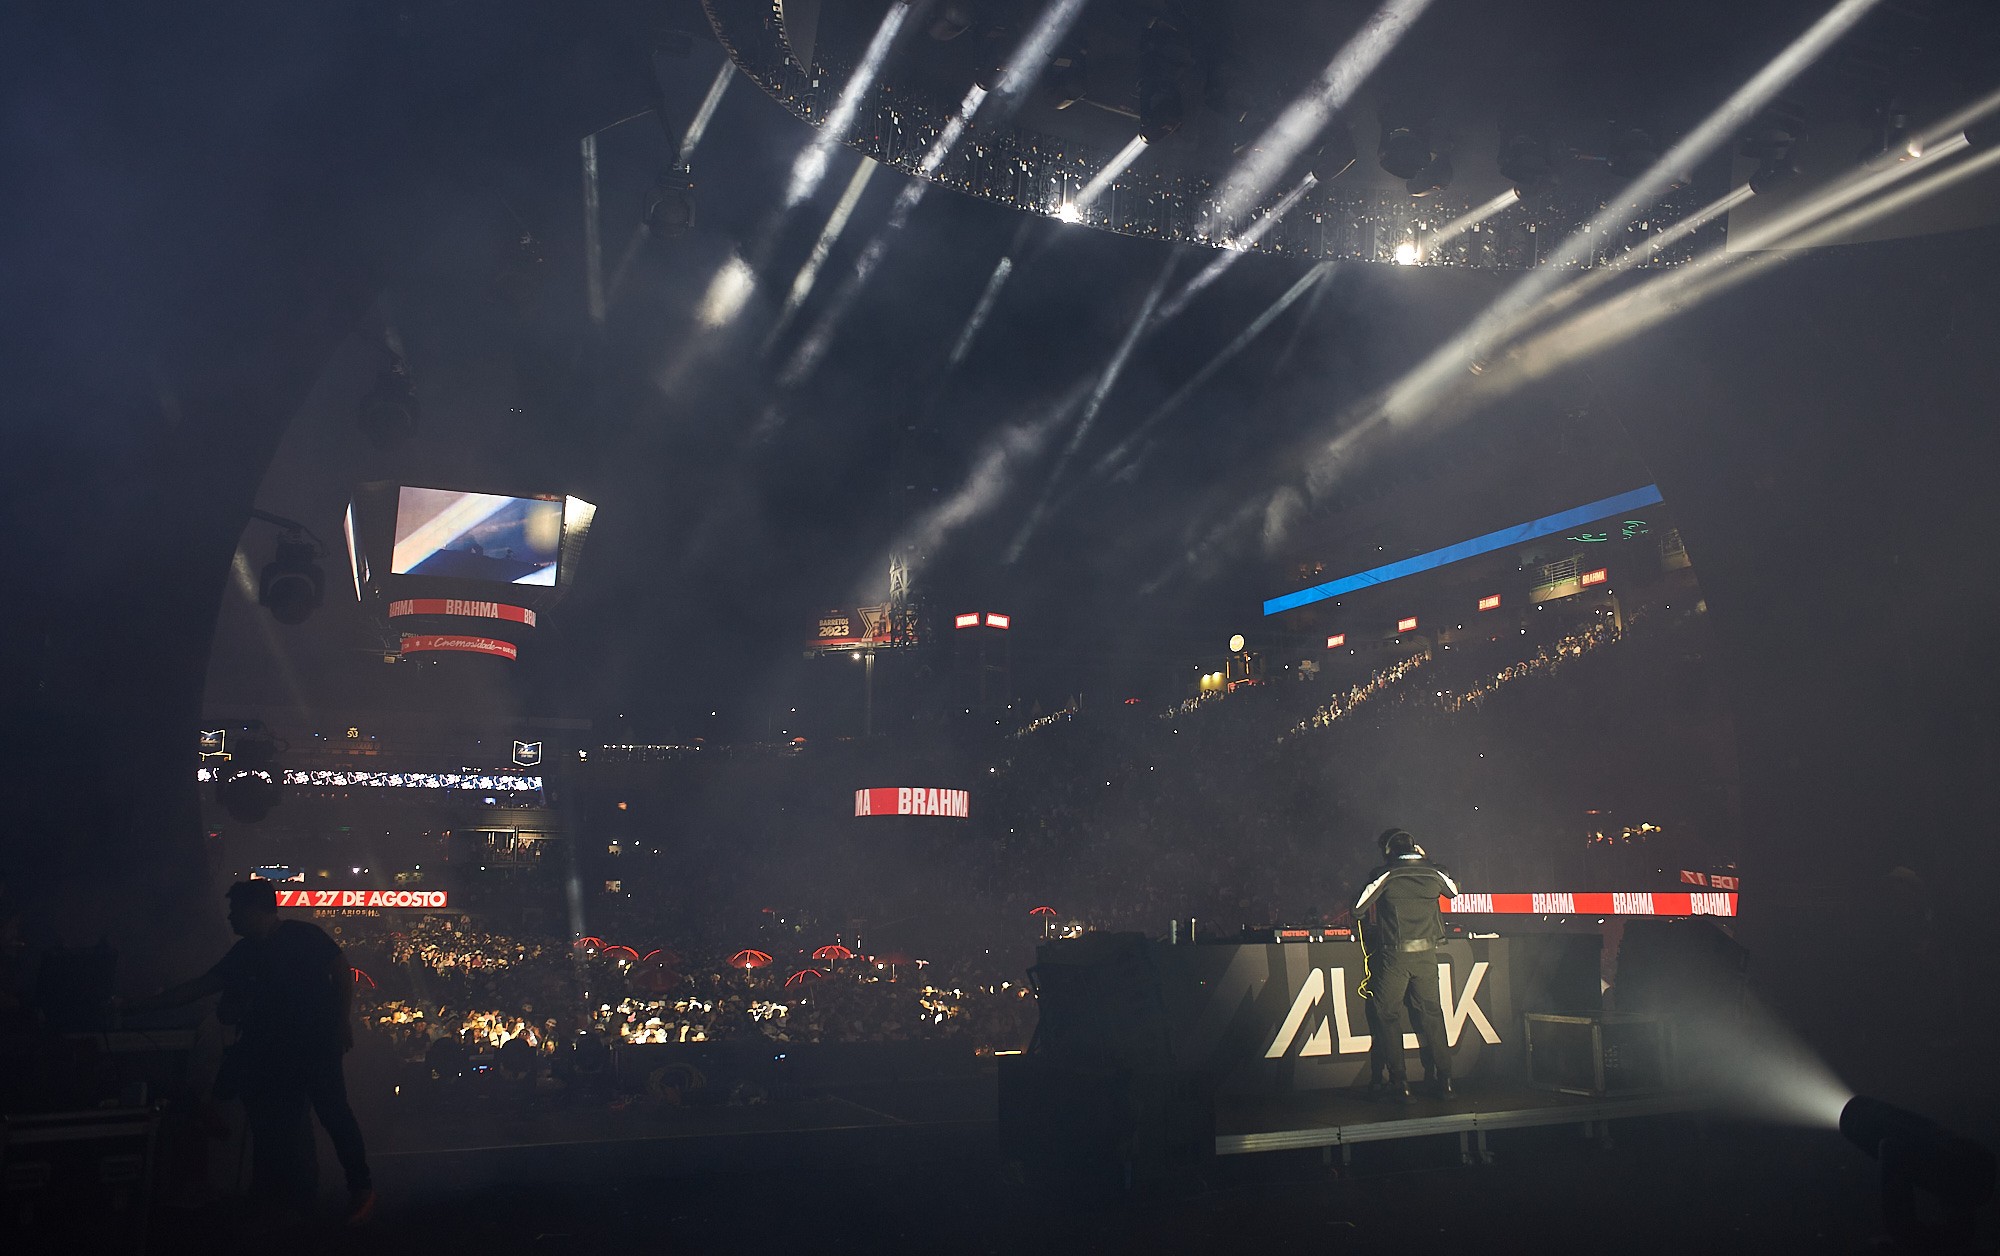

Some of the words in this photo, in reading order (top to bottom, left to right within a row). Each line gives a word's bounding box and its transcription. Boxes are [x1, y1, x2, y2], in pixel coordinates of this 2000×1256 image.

[446, 600, 498, 618] BRAHMA
[819, 618, 849, 626] BARRETOS
[819, 626, 849, 636] 2023
[898, 788, 968, 817] BRAHMA
[296, 891, 310, 906] A
[315, 891, 339, 906] 27
[343, 891, 365, 906] DE
[368, 891, 446, 906] AGOSTO
[1451, 893, 1493, 913] BRAHMA
[1532, 893, 1575, 914] BRAHMA
[1613, 893, 1655, 915] BRAHMA
[1690, 893, 1732, 916] BRAHMA
[1265, 962, 1502, 1058] ALK
